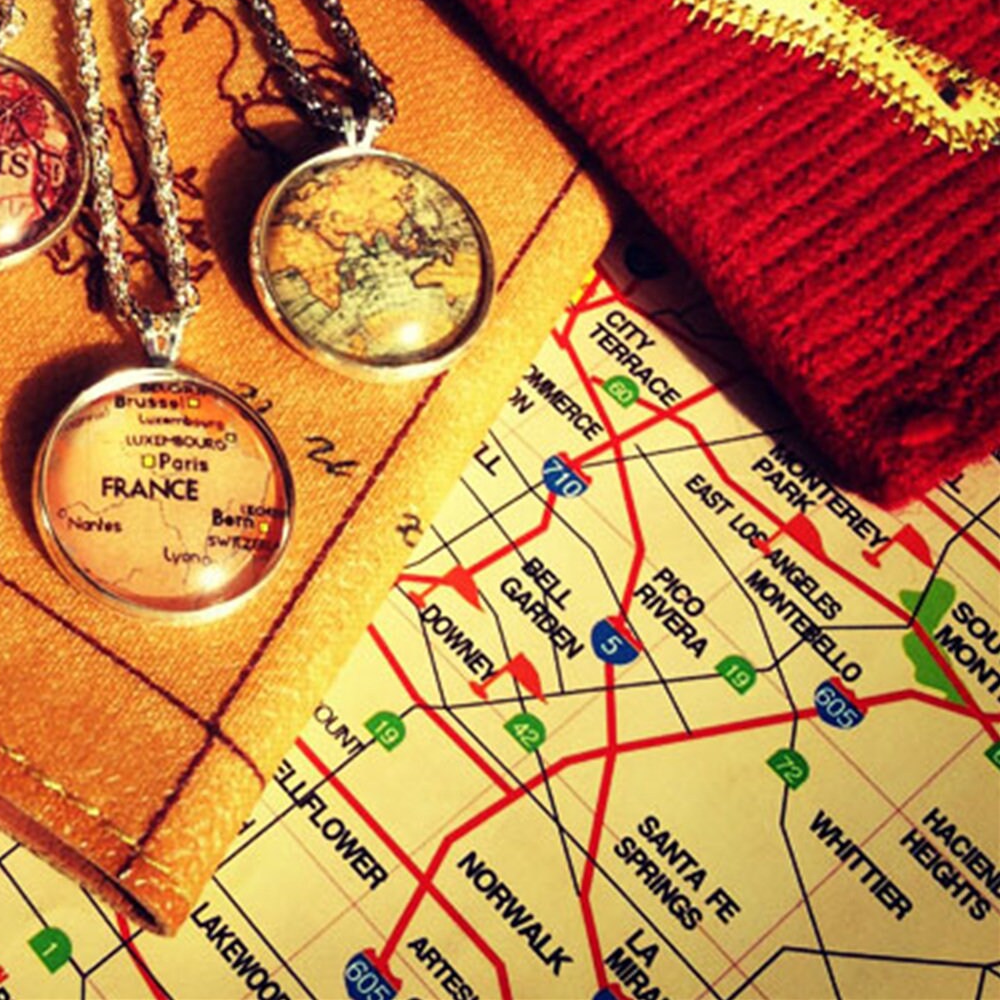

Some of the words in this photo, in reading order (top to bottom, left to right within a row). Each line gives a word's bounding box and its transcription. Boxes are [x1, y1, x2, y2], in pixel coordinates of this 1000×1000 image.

[603, 309, 658, 351] CITY
[588, 322, 683, 407] TERRACE
[126, 434, 227, 451] LUXEMBOURG
[159, 452, 209, 472] Paris
[101, 476, 200, 502] FRANCE
[543, 459, 584, 499] 710
[751, 456, 818, 514] PARK
[769, 442, 891, 549] MONTEREY
[68, 515, 123, 533] Nantes
[211, 506, 255, 528] Bern
[163, 546, 201, 566] Lyon
[684, 473, 735, 517] EAST
[728, 512, 769, 549] LOS
[764, 548, 843, 621] ANGELES
[521, 556, 576, 612] BELL
[651, 566, 706, 618] PICO
[499, 575, 586, 660] GARDEN
[633, 583, 710, 659] RIVERA
[744, 568, 863, 683] MONTEBELLO
[420, 602, 498, 682] DOWNEY
[600, 632, 620, 655] 5
[726, 664, 750, 688] 19
[815, 685, 859, 729] 605
[373, 718, 400, 744] 19
[511, 720, 537, 747] 42
[775, 754, 804, 784] 72
[613, 835, 703, 932] SPRINGS
[637, 814, 708, 893] SANTA
[703, 886, 742, 925] FE
[808, 808, 914, 921] WHITTIER
[899, 828, 993, 922] HEIGHTS
[456, 850, 574, 977] NORWALK
[624, 928, 660, 968] LA
[344, 960, 393, 1000] 605
